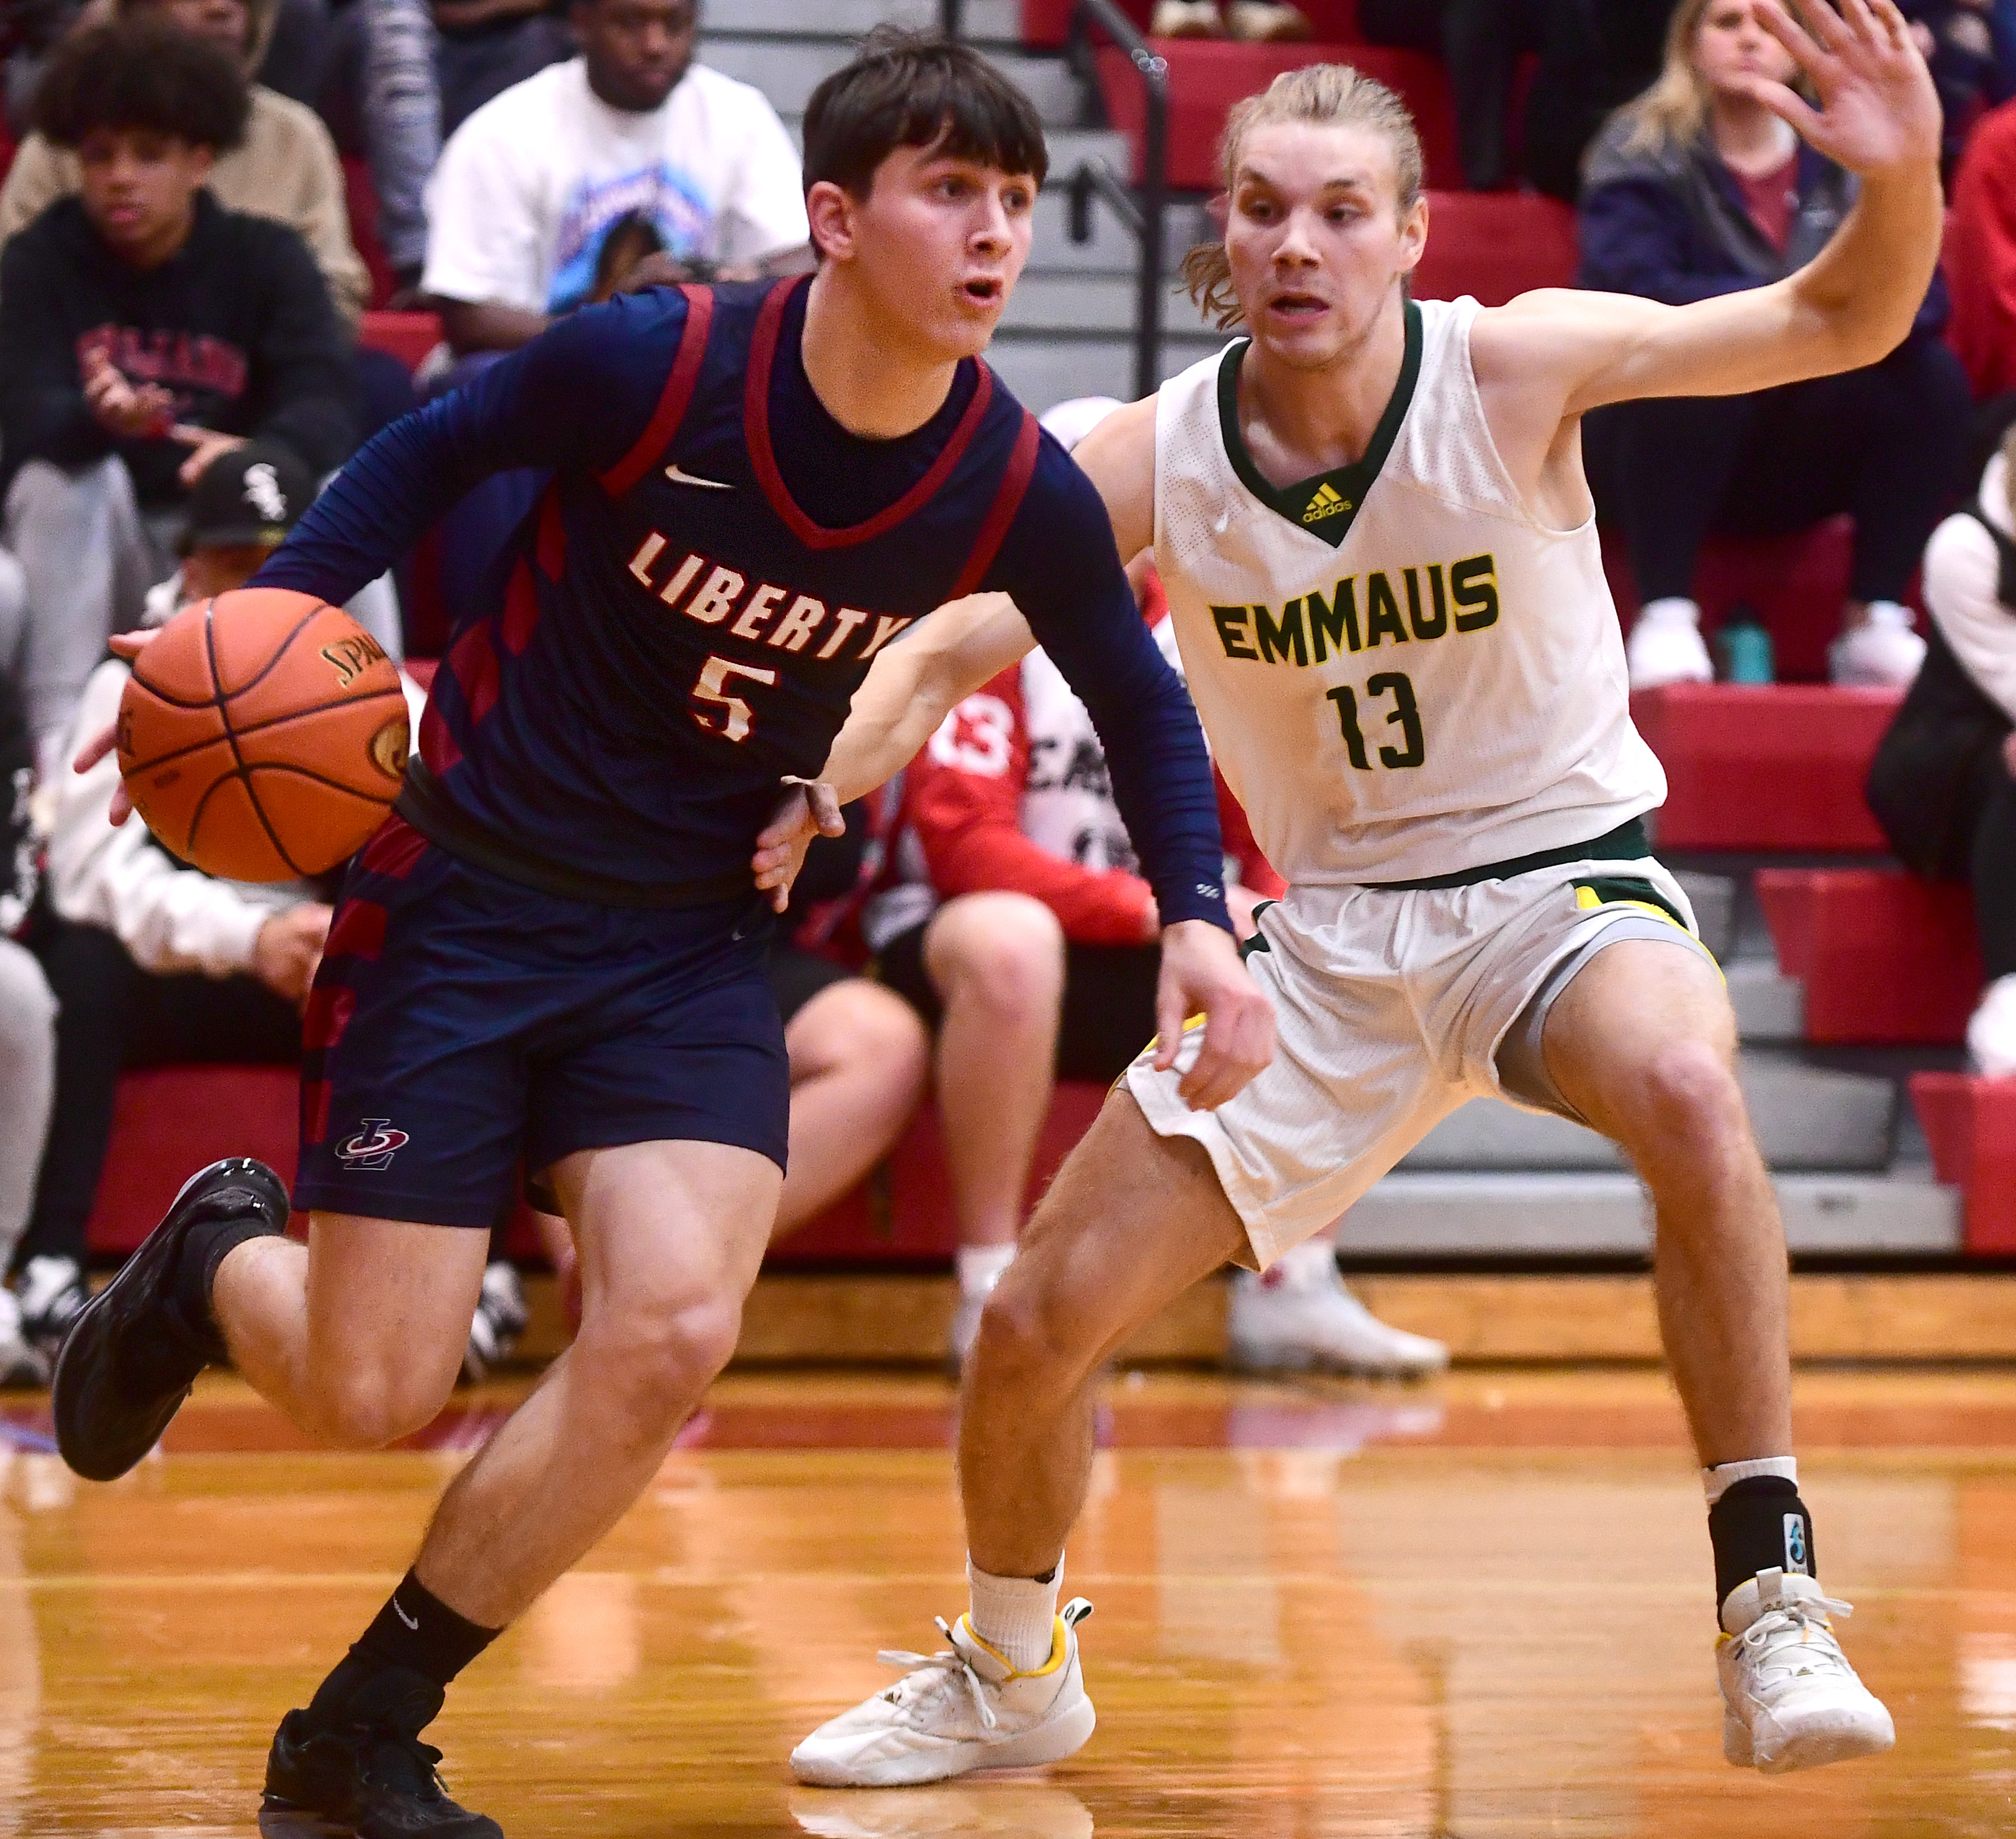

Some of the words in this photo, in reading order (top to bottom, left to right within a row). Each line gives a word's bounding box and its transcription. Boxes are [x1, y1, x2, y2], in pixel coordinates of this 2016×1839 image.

[1303, 500, 1352, 522] adidas
[626, 530, 913, 661] LIBERTY
[1208, 551, 1499, 667] EMMAUS
[690, 654, 779, 743] 5
[1326, 672, 1424, 770] 13
